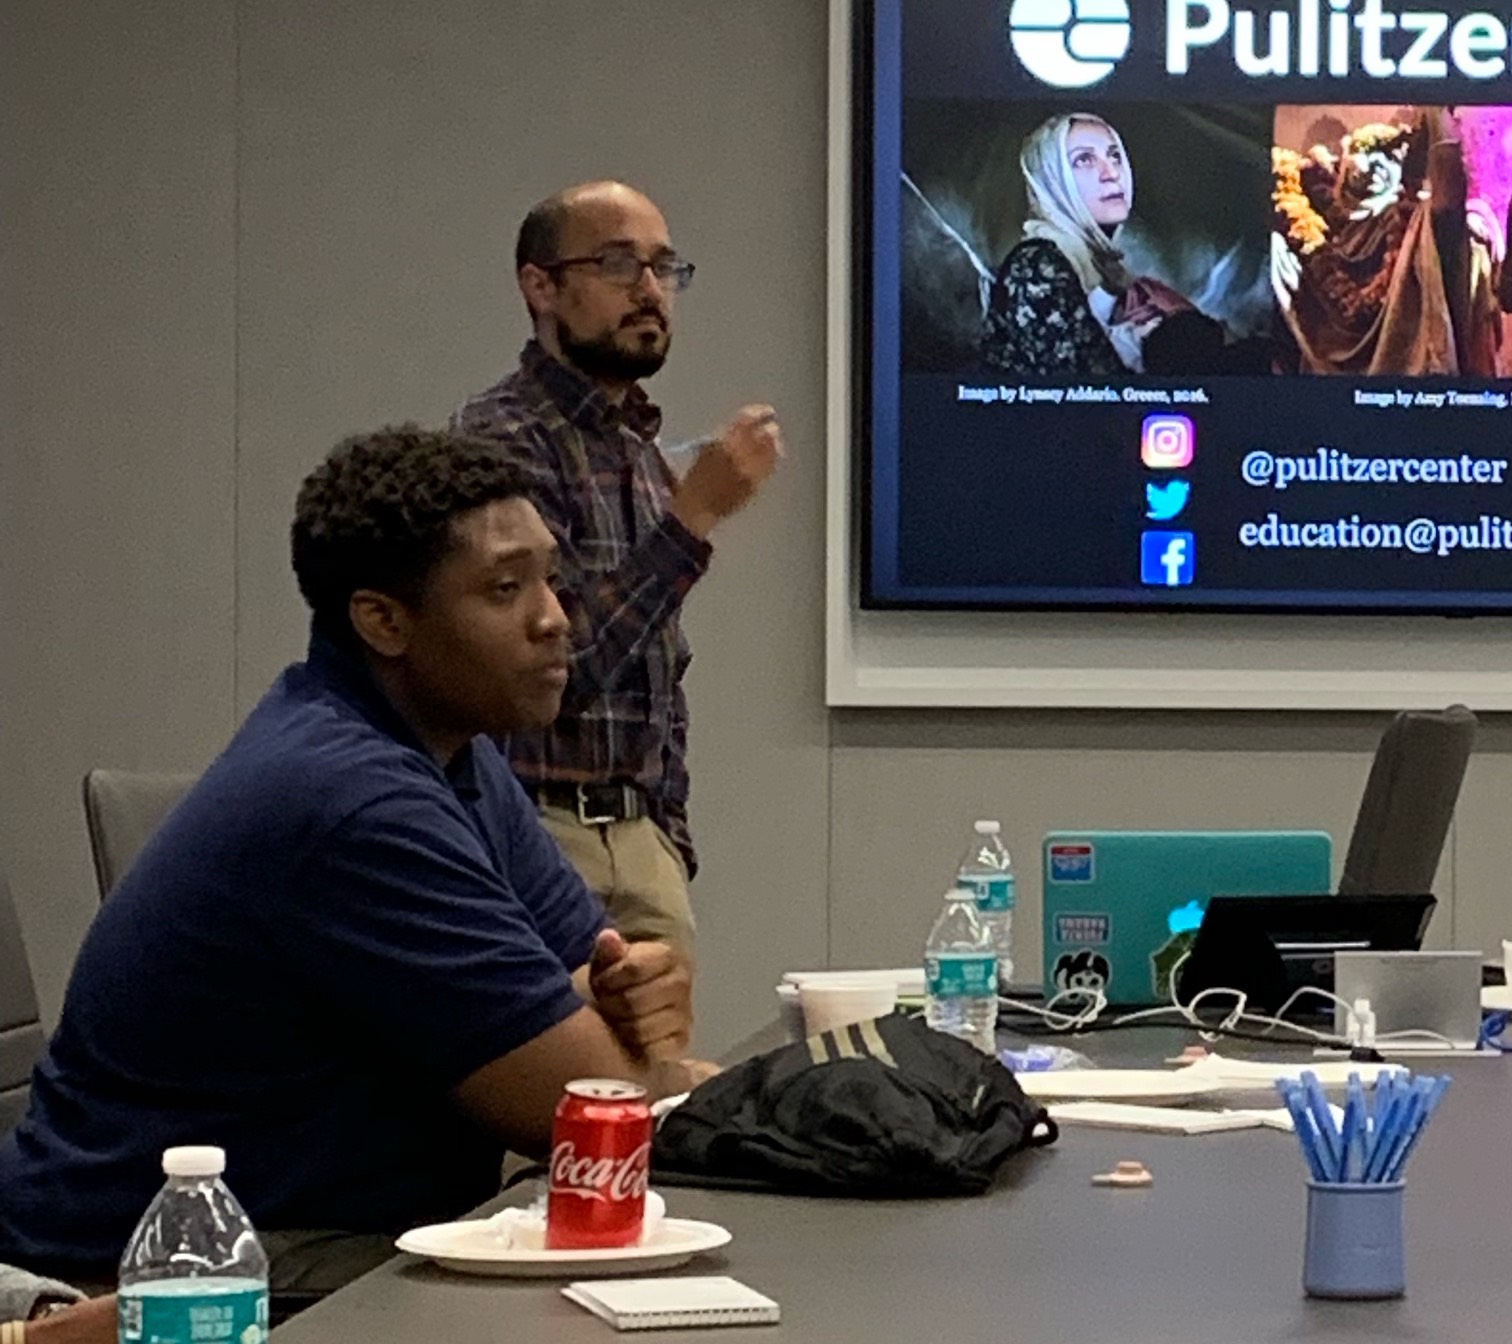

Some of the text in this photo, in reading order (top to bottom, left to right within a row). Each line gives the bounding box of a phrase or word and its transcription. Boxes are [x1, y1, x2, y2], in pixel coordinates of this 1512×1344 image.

[1000, 386, 1017, 404] by
[1397, 389, 1414, 407] by
[1241, 448, 1508, 488] @pulitzercenter
